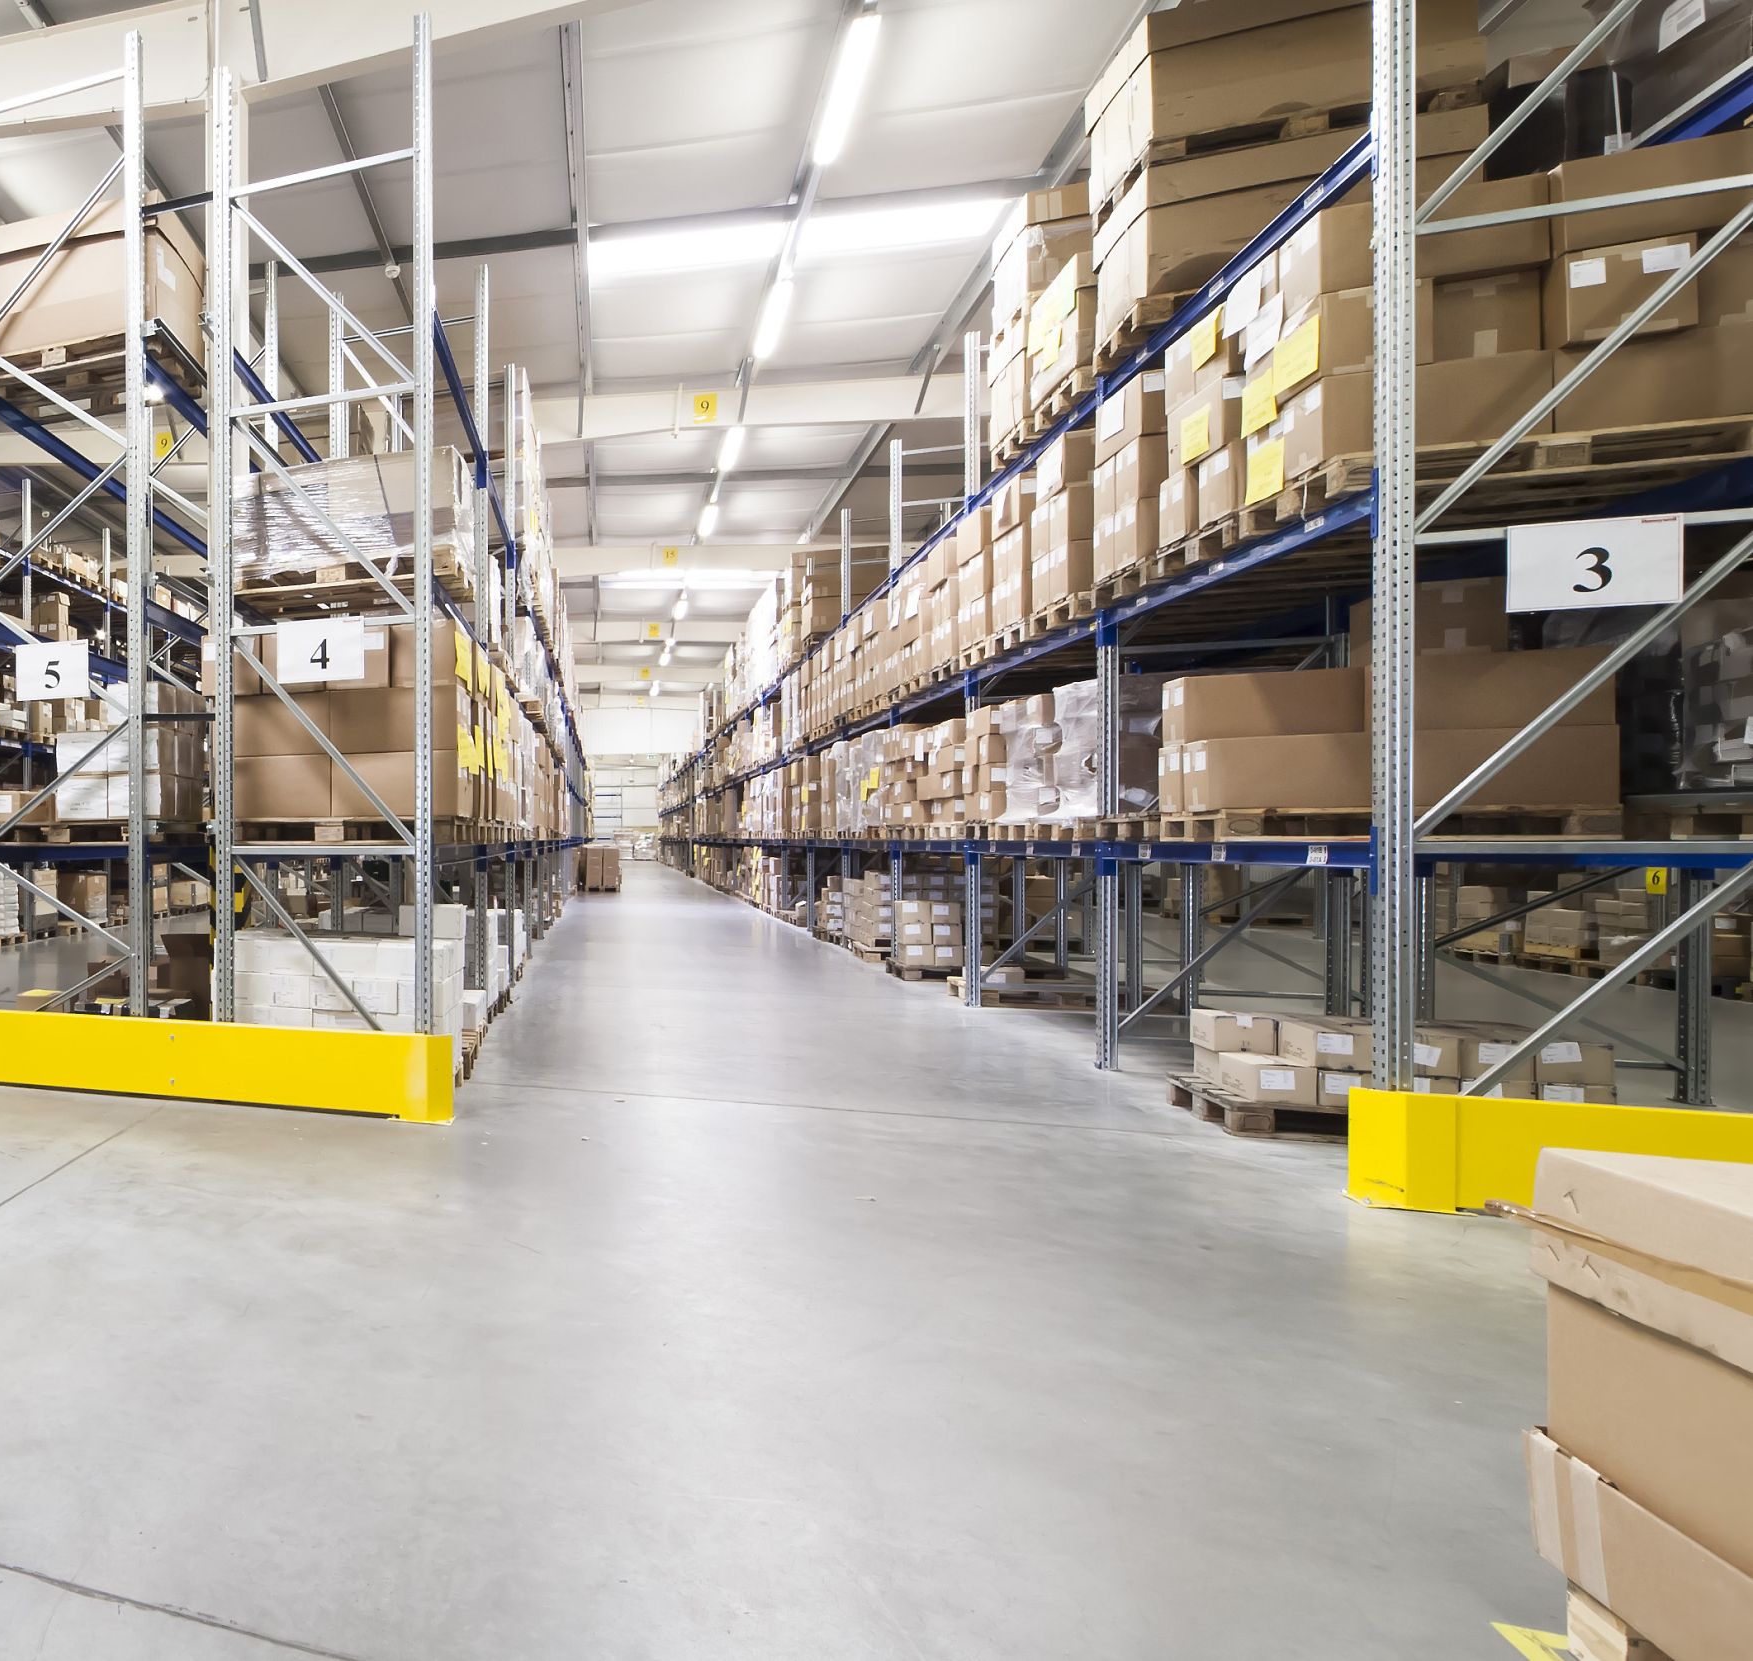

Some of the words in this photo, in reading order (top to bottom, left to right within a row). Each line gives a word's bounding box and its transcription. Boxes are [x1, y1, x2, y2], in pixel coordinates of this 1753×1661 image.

[700, 400, 710, 412] 9
[160, 438, 168, 448] 9
[1572, 546, 1613, 593] 3
[309, 638, 330, 669] 4
[44, 660, 61, 689] 5
[1651, 870, 1661, 885] 6
